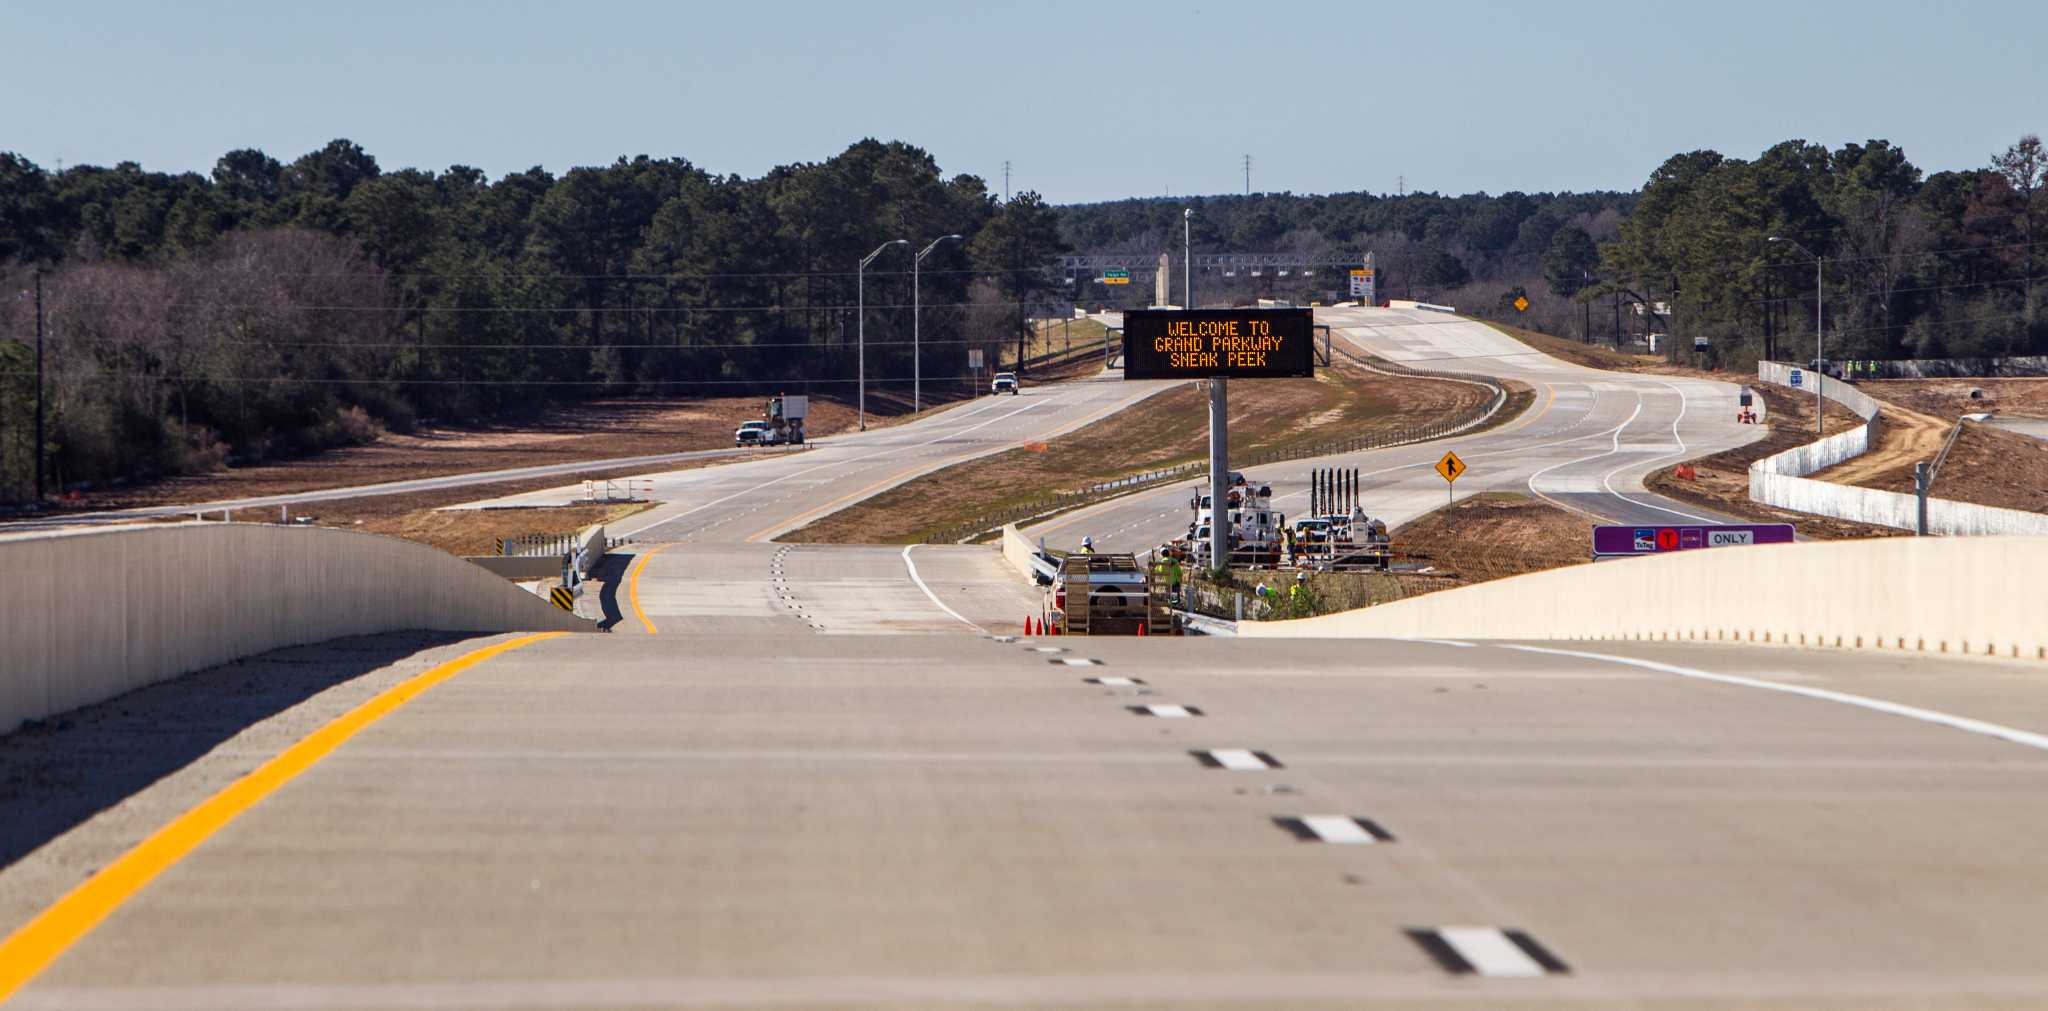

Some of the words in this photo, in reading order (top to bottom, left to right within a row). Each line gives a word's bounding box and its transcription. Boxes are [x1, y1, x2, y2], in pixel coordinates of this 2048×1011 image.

[1168, 321, 1239, 336] WELCOME
[1249, 321, 1269, 336] TO
[1155, 337, 1203, 352] GRAND
[1212, 336, 1283, 351] PARKWAY
[1170, 352, 1218, 367] SNEAK
[1228, 352, 1266, 367] PEEK
[1714, 533, 1747, 544] ONLY
